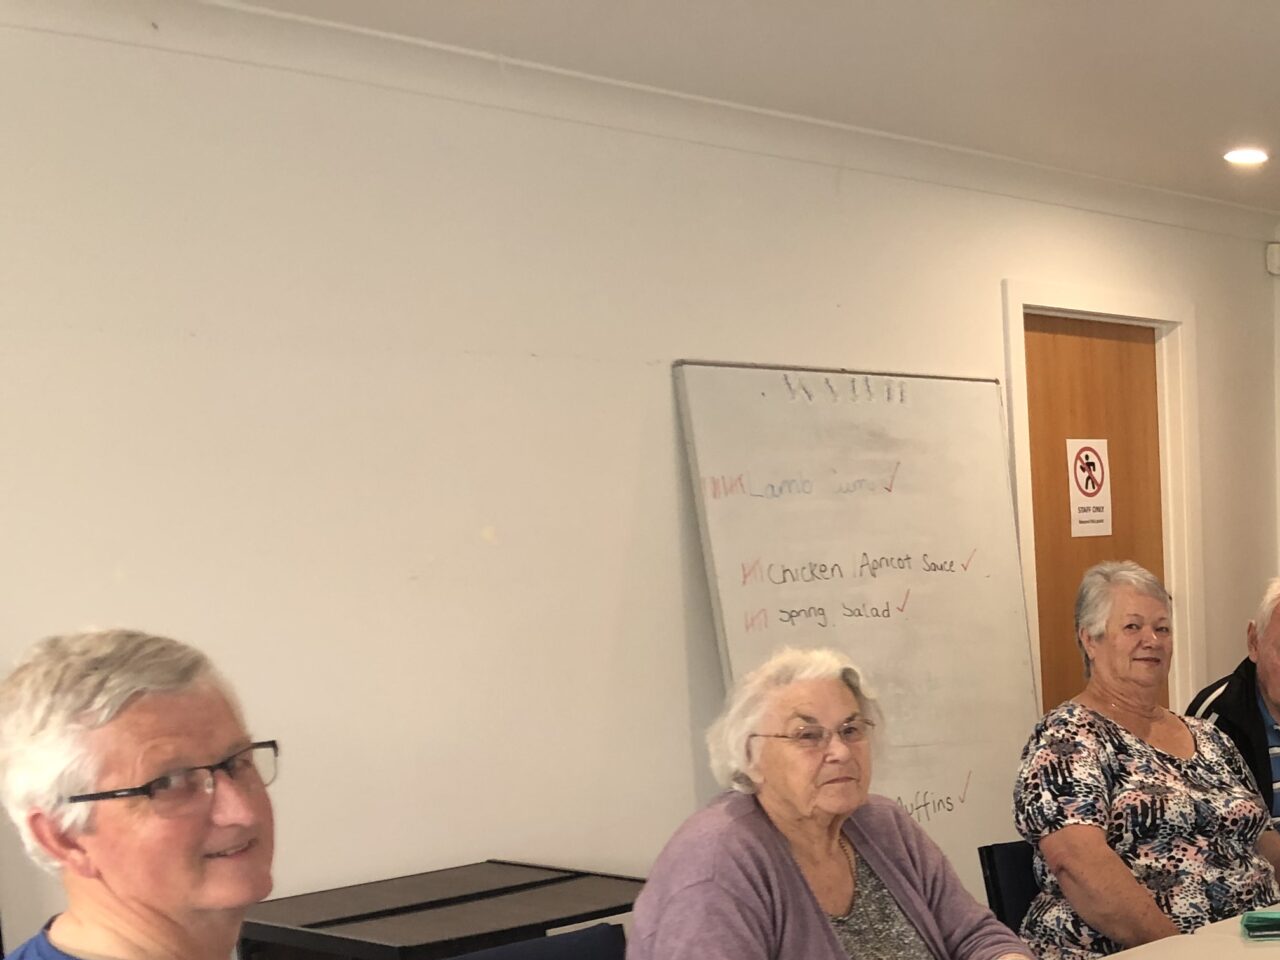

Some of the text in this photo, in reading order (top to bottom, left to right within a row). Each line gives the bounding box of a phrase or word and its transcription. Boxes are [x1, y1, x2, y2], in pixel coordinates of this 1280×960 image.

[768, 561, 843, 584] Chicken
[922, 554, 956, 573] Sauce
[842, 602, 891, 618] Salad
